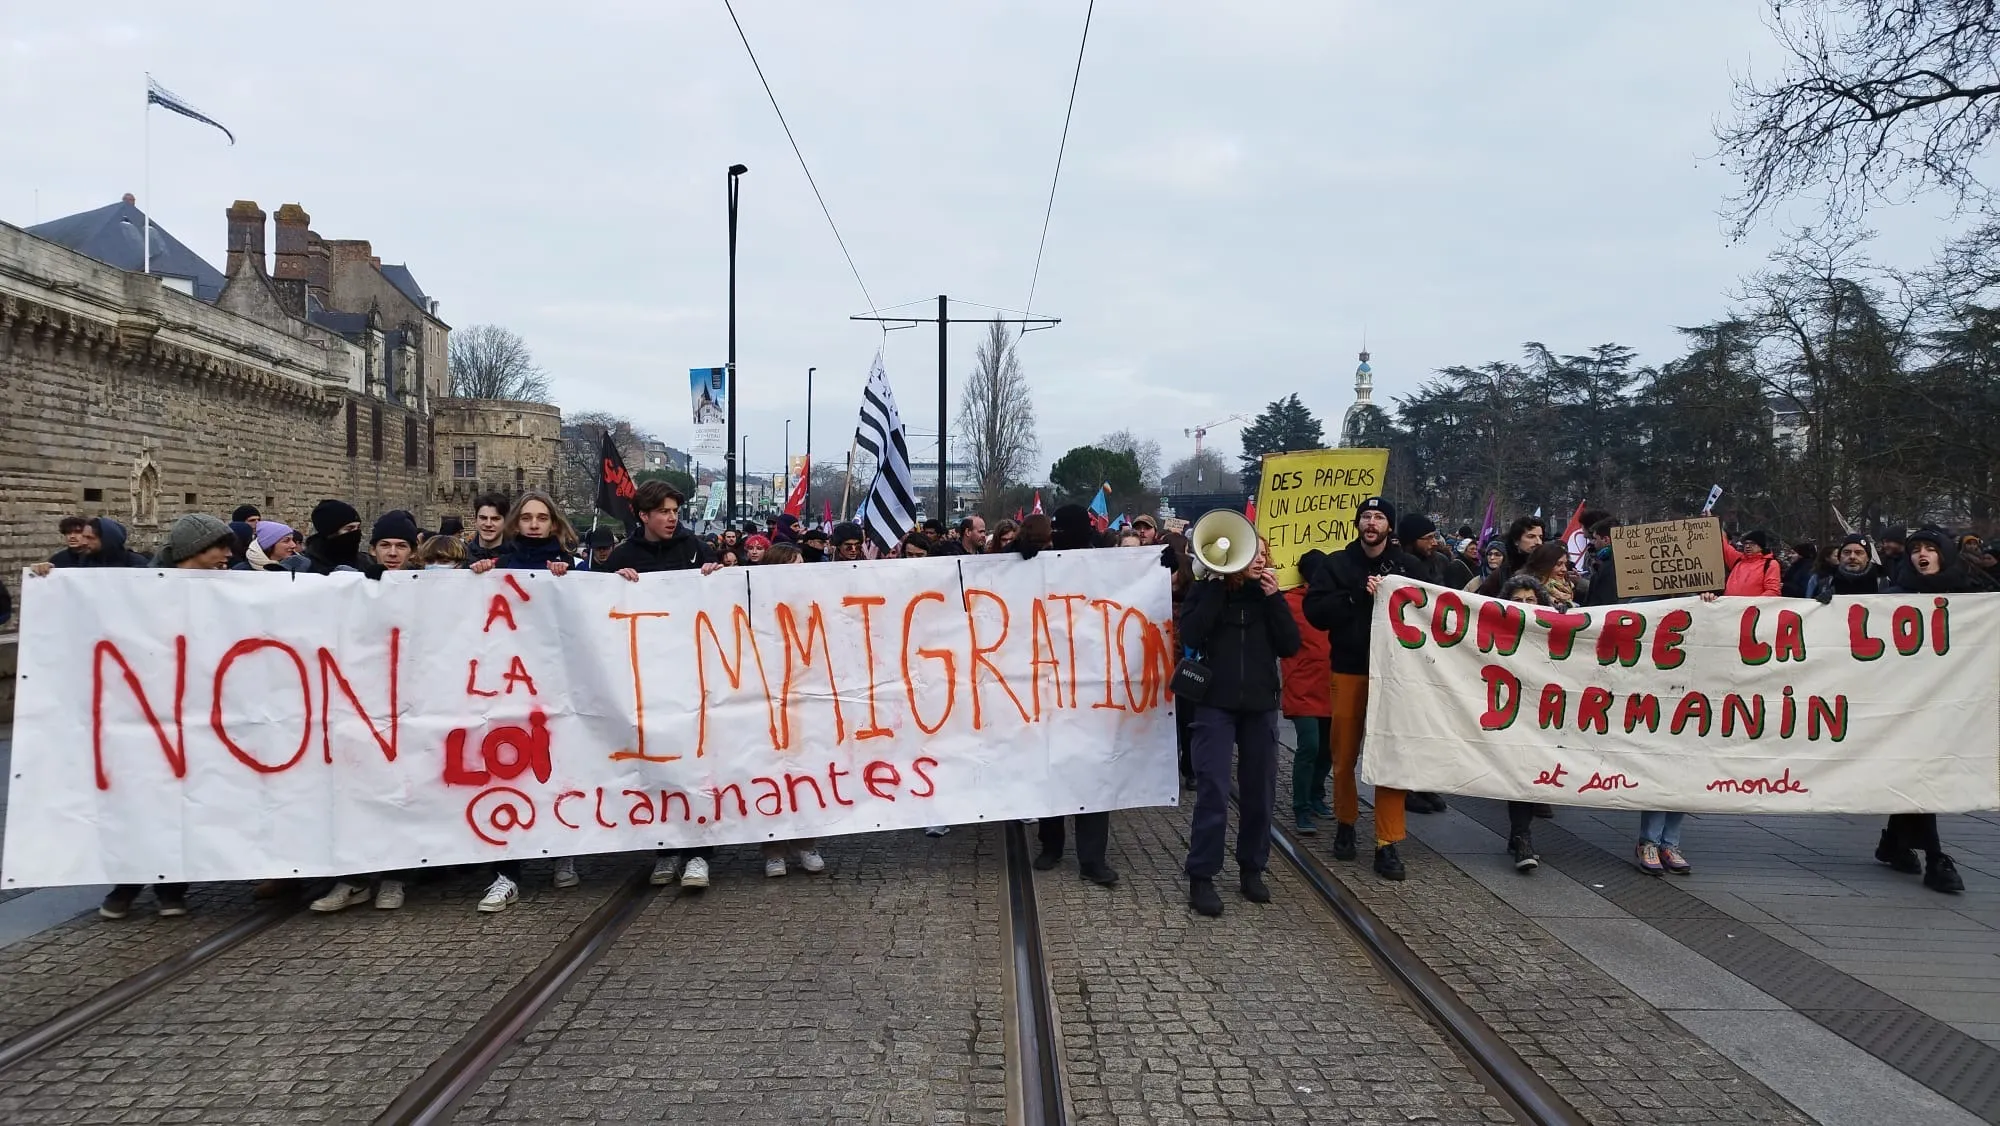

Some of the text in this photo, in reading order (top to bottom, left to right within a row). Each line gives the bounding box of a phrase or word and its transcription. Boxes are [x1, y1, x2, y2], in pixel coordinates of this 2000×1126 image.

[1271, 468, 1375, 491] DES PAPIERS
[1269, 498, 1289, 519] UN
[1268, 520, 1357, 548] ET LA SANT
[1644, 523, 1677, 542] grand
[1682, 519, 1712, 532] temps
[1649, 544, 1684, 559] CRA
[1651, 557, 1703, 574] CESEDA
[483, 573, 532, 634] À
[1388, 585, 1693, 671] CONTRE
[1738, 605, 1807, 666] LA
[466, 655, 538, 698] LA
[608, 588, 1174, 763] IMMIGRATION
[1181, 668, 1205, 683] MIPRO
[91, 626, 401, 792] NON
[1532, 762, 1809, 794] et son monde
